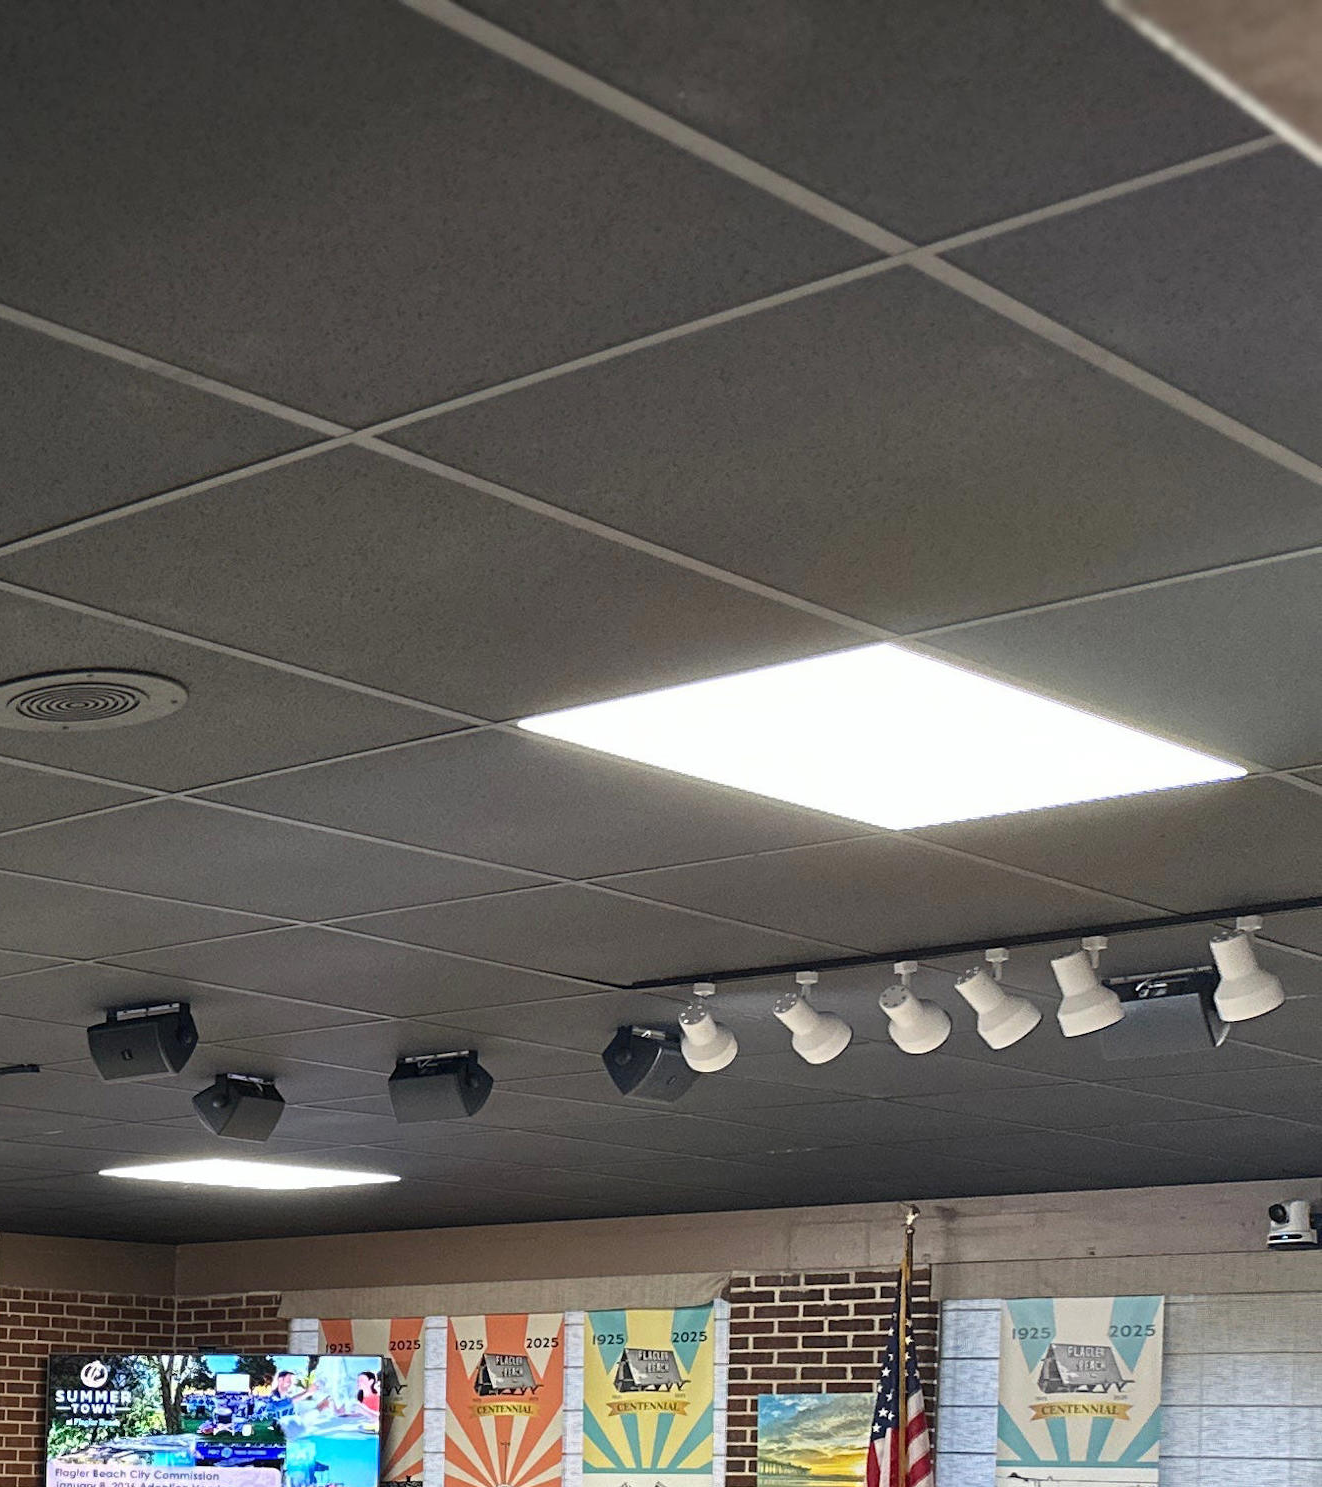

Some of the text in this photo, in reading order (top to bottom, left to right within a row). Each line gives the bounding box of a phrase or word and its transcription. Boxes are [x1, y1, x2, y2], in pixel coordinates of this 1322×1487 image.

[592, 1331, 708, 1345] 1925 2025
[1012, 1325, 1156, 1340] 1925 2025
[326, 1340, 421, 1354] 1925 2025
[455, 1337, 559, 1351] 1925 2025
[55, 1389, 132, 1403] SUMMER
[71, 1403, 117, 1414] TOWN
[477, 1404, 532, 1414] CENTENNIAL
[617, 1402, 680, 1412] CENTENNIAL
[1041, 1404, 1120, 1415] CENTENNIAL
[55, 1468, 220, 1481] Flagler Beach City Commission
